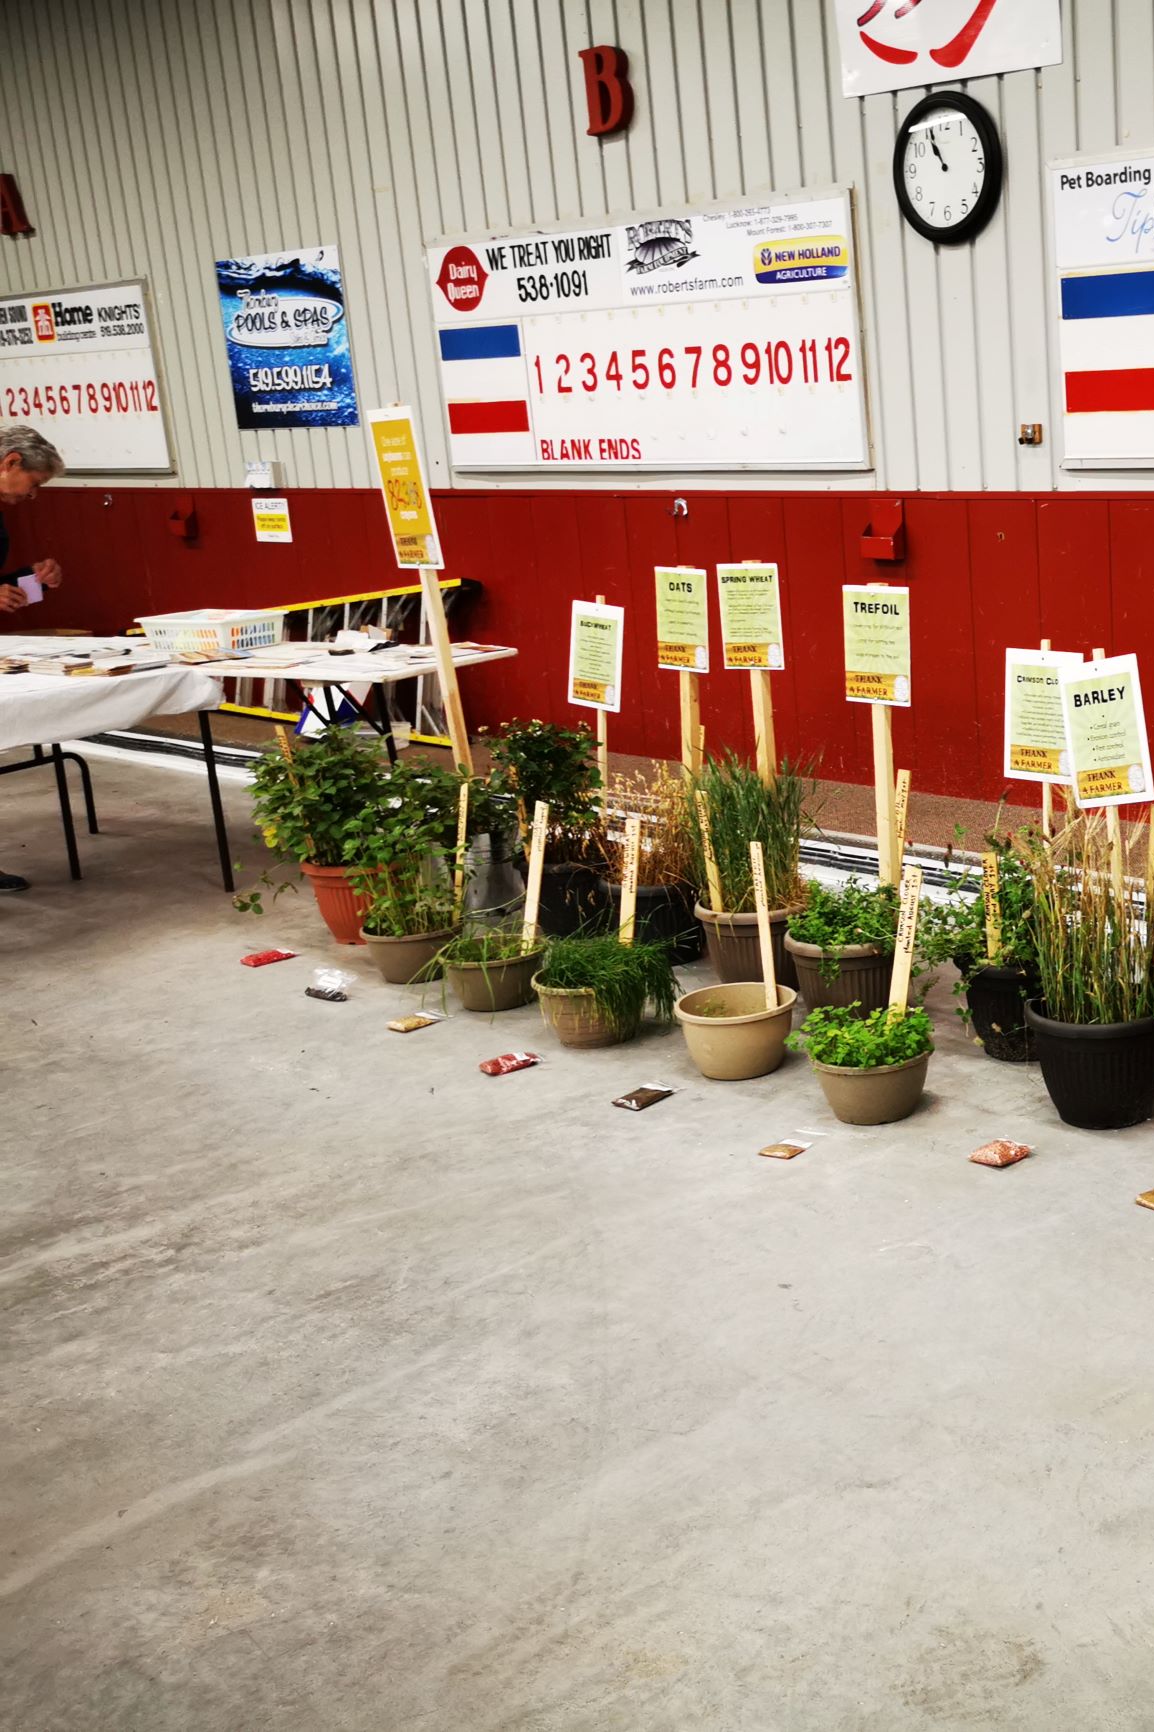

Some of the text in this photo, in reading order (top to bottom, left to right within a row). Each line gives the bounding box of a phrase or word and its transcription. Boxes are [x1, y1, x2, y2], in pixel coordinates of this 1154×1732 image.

[578, 45, 634, 136] B
[913, 142, 926, 158] 10
[970, 136, 978, 153] 2
[908, 163, 917, 179] 9
[976, 157, 985, 174] 3
[1060, 173, 1082, 190] Pet
[1085, 167, 1151, 187] Boarding
[915, 186, 923, 202] 8
[971, 182, 979, 198] 4
[928, 201, 936, 217] 7
[943, 205, 952, 221] 6
[960, 199, 969, 215] 5
[486, 233, 612, 271] WE TREAT YOU RIGHT
[775, 246, 841, 262] NEW HOLLAND
[449, 261, 478, 281] Dairy
[775, 266, 828, 281] AGRICULTURE
[447, 282, 480, 302] Queen
[630, 275, 744, 296] www.robertsfarm.com
[51, 302, 93, 327] Home
[234, 306, 330, 333] POOLS & SPAS
[534, 336, 853, 394] 1 2 3 4 5 6 7 8 9 10 11 12
[5, 380, 159, 417] 2 3 4 5 6 7 8 9 10 11 12
[540, 438, 642, 461] BLANK ENDS
[721, 574, 773, 584] SPRING WHEAT
[668, 582, 693, 593] OATS
[853, 601, 900, 616] TREFOIL
[1073, 686, 1126, 708] BARLEY
[1020, 748, 1048, 758] THANK
[1021, 760, 1052, 769] FARMER
[1087, 770, 1116, 782] THANK
[1090, 782, 1124, 793] FARMER
[903, 925, 913, 953] planted
